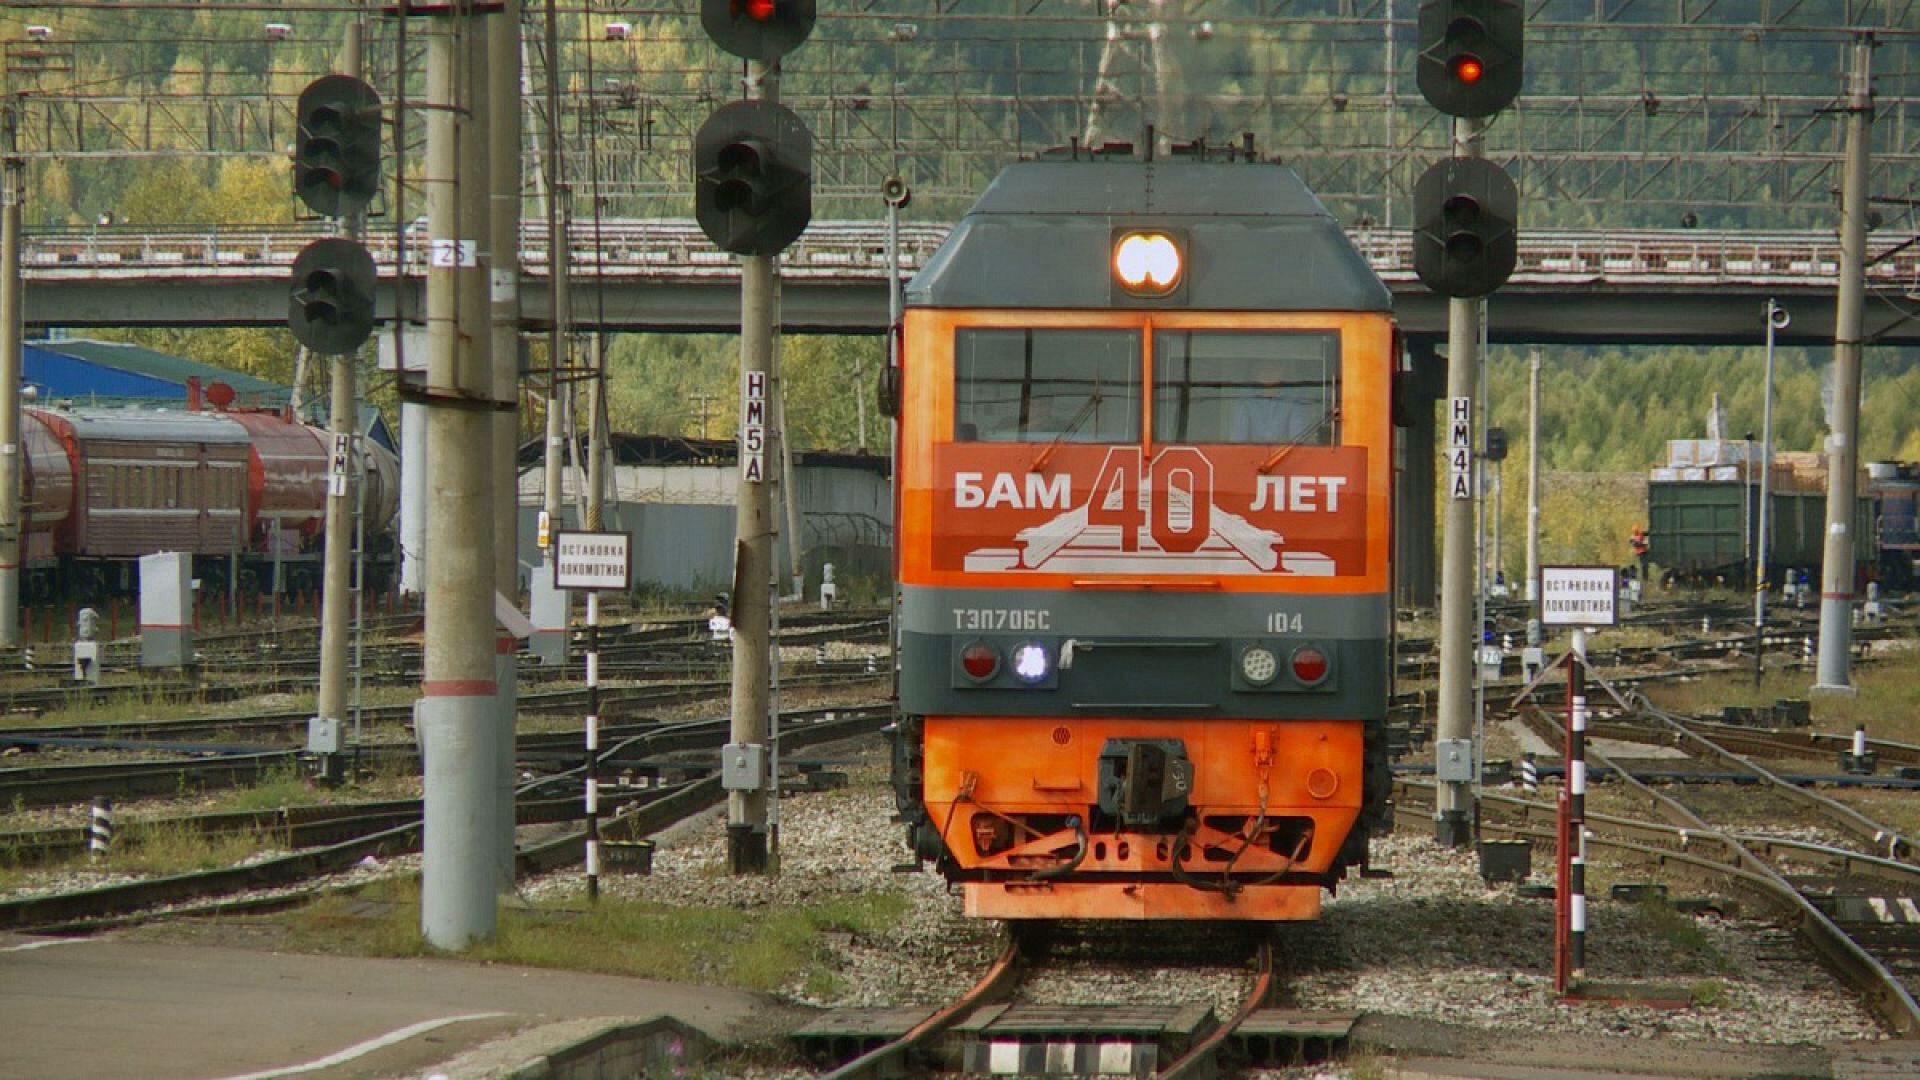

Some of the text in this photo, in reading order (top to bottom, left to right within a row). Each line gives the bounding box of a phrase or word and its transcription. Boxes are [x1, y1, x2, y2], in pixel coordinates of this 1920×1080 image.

[746, 373, 763, 480] НМ5А
[1453, 399, 1468, 497] НМ4А
[954, 446, 1347, 554] БАМ 40 ЛЕТ
[561, 544, 624, 556] ОСТАНОВКА
[560, 563, 625, 577] ЛОКОМОТИВА
[1546, 580, 1611, 592] ОСТАНОВКА
[1545, 599, 1612, 612] ЛОКОМОТИВА
[952, 608, 1051, 630] ТЭП70БС
[1267, 612, 1304, 633] 104
